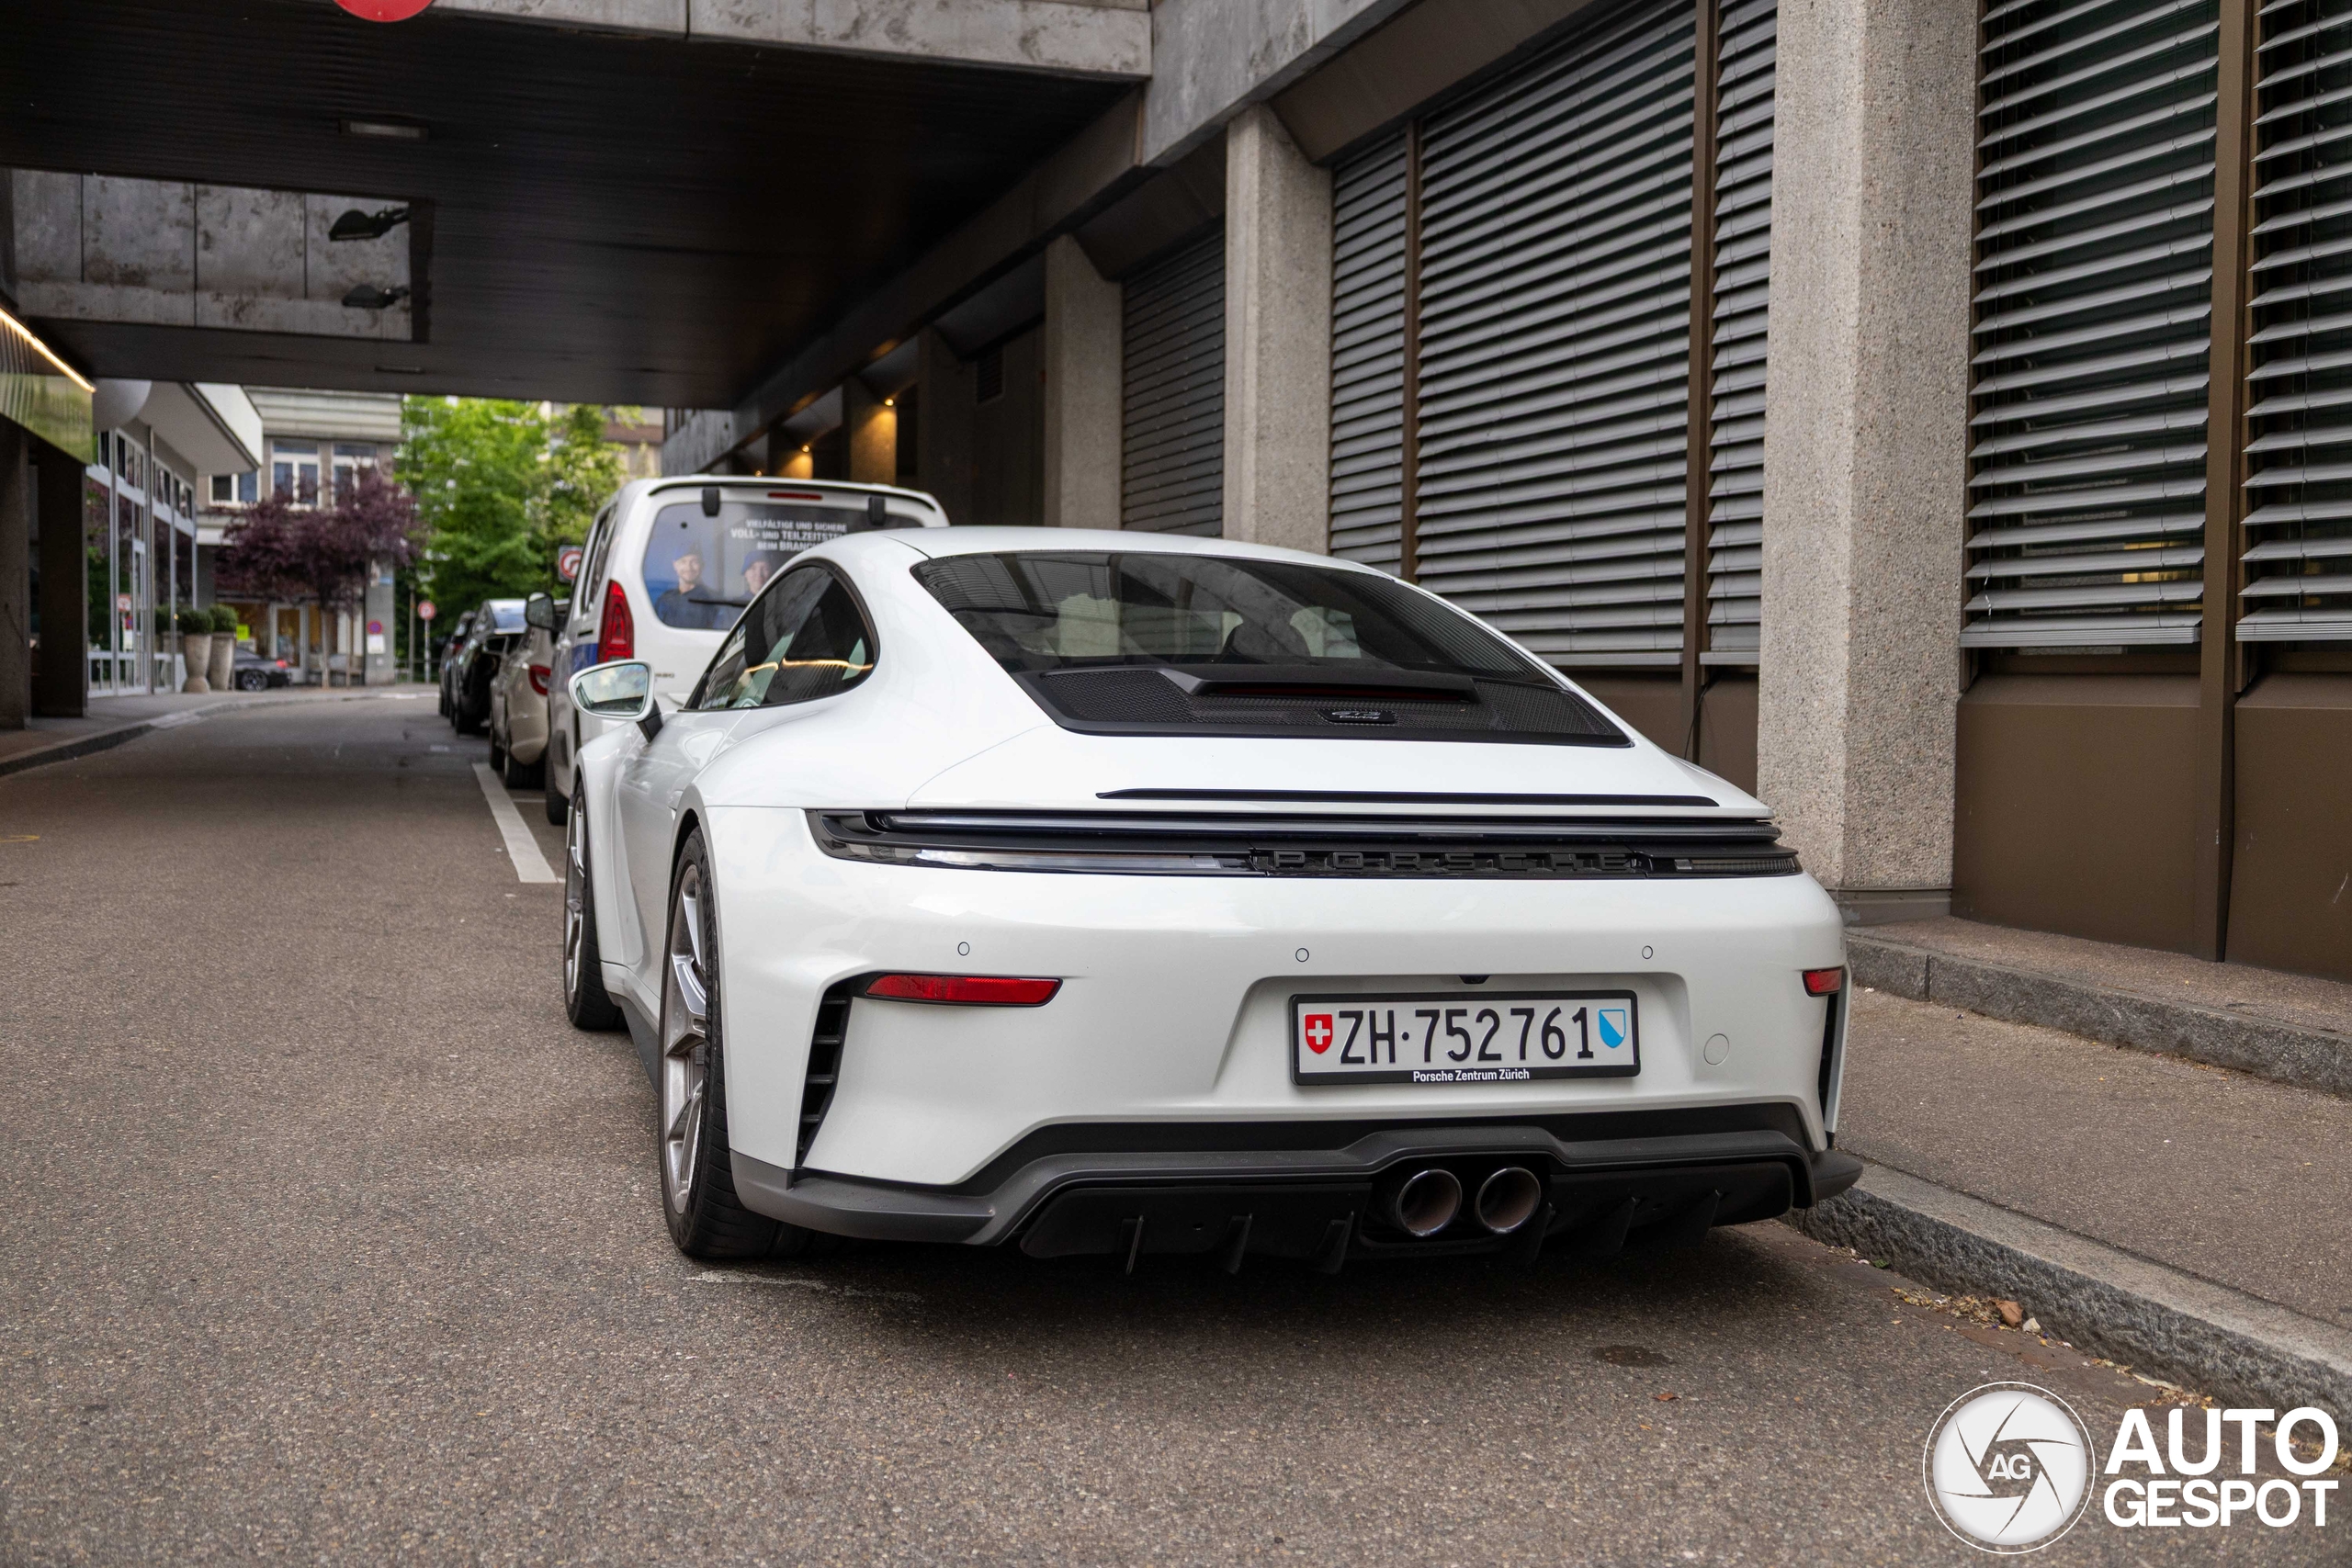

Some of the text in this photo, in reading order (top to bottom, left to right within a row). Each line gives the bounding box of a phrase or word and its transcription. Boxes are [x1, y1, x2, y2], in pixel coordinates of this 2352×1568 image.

[746, 519, 847, 533] VIELFÄLTIGE UND SICHERE
[730, 528, 759, 539] VOLL-
[762, 531, 780, 540] UND
[757, 541, 778, 551] BEIM
[1273, 851, 1629, 871] PORSCHE
[704, 958, 713, 1084] MICHELIN
[1413, 1068, 1530, 1082] Porsche Zentrum Zürich
